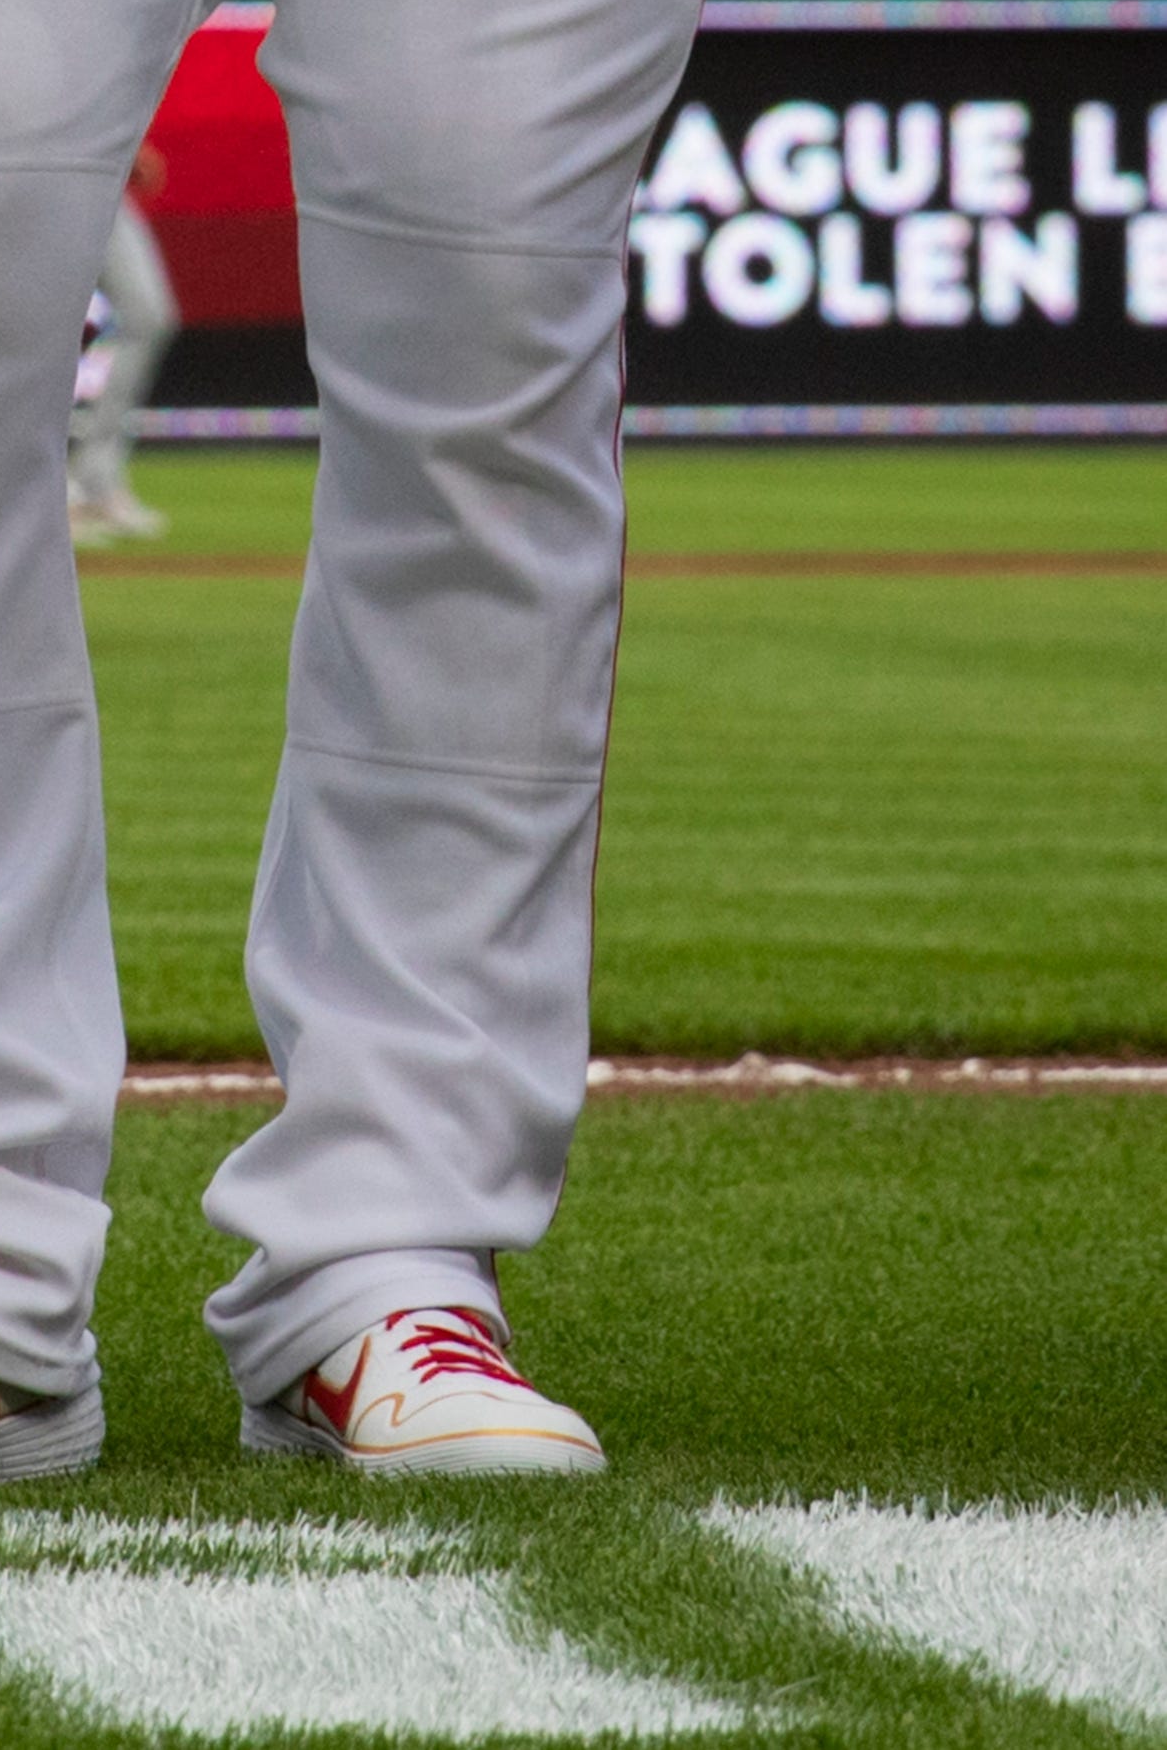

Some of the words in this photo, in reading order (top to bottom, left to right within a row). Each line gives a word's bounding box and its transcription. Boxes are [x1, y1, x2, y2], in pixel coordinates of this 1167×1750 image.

[634, 100, 1032, 215] AGUE
[1072, 100, 1167, 215] L
[631, 212, 1077, 327] TOLEN
